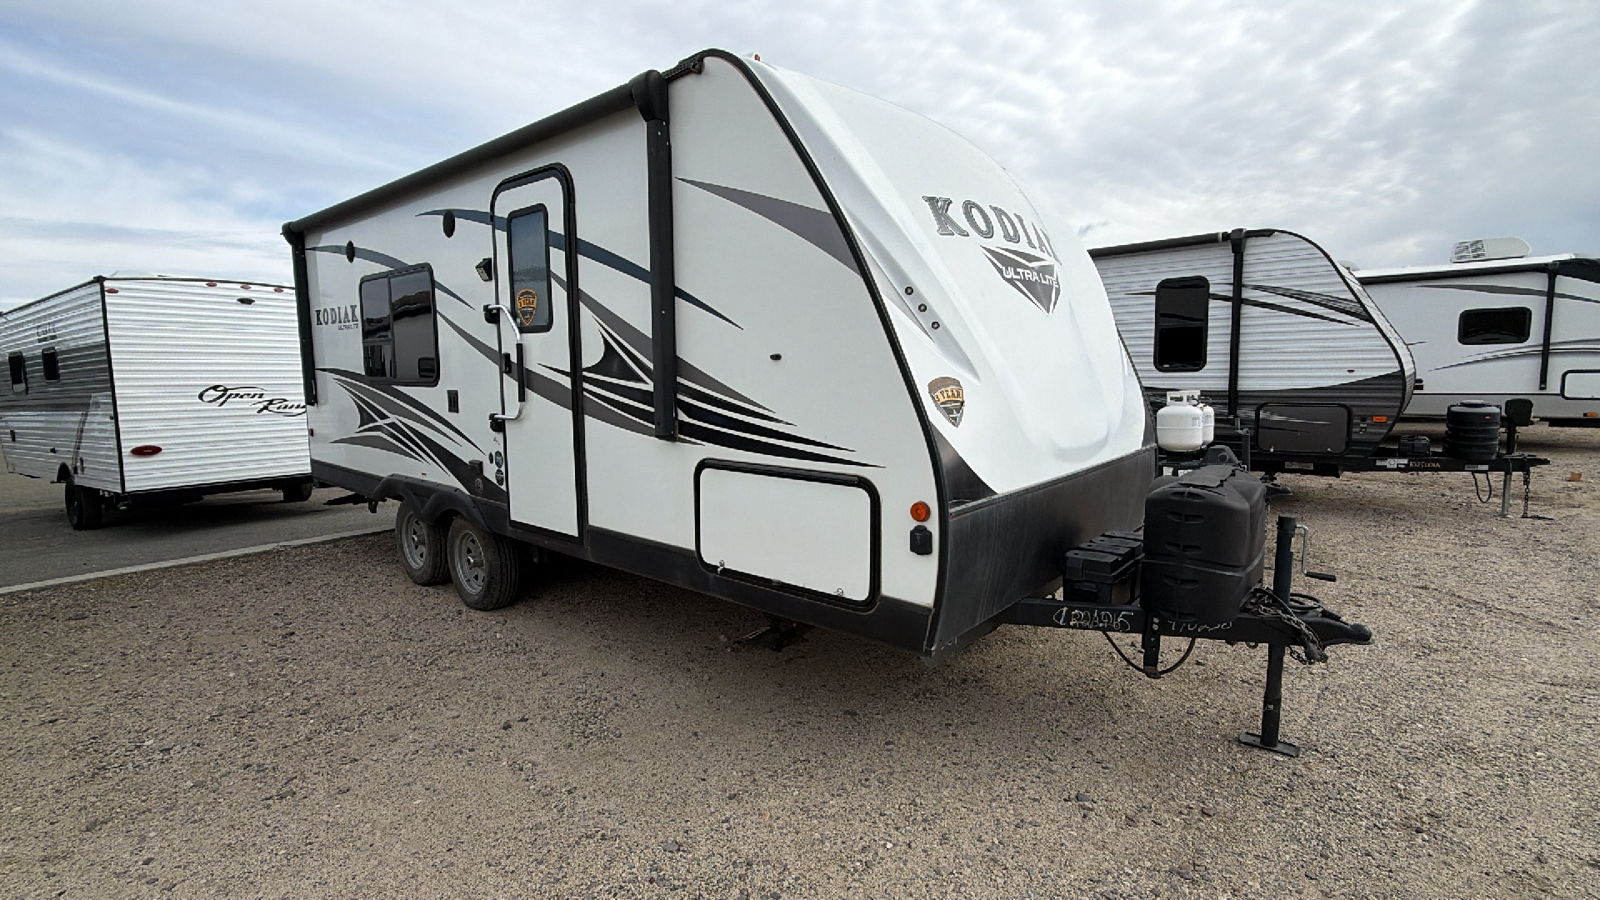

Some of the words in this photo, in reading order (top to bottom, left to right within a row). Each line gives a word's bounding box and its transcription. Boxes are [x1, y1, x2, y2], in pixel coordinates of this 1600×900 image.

[1001, 266, 1040, 283] ULTRA
[1040, 272, 1060, 289] LITE
[315, 304, 358, 326] KODIAK
[198, 385, 267, 407] Open
[940, 389, 962, 400] YEAR
